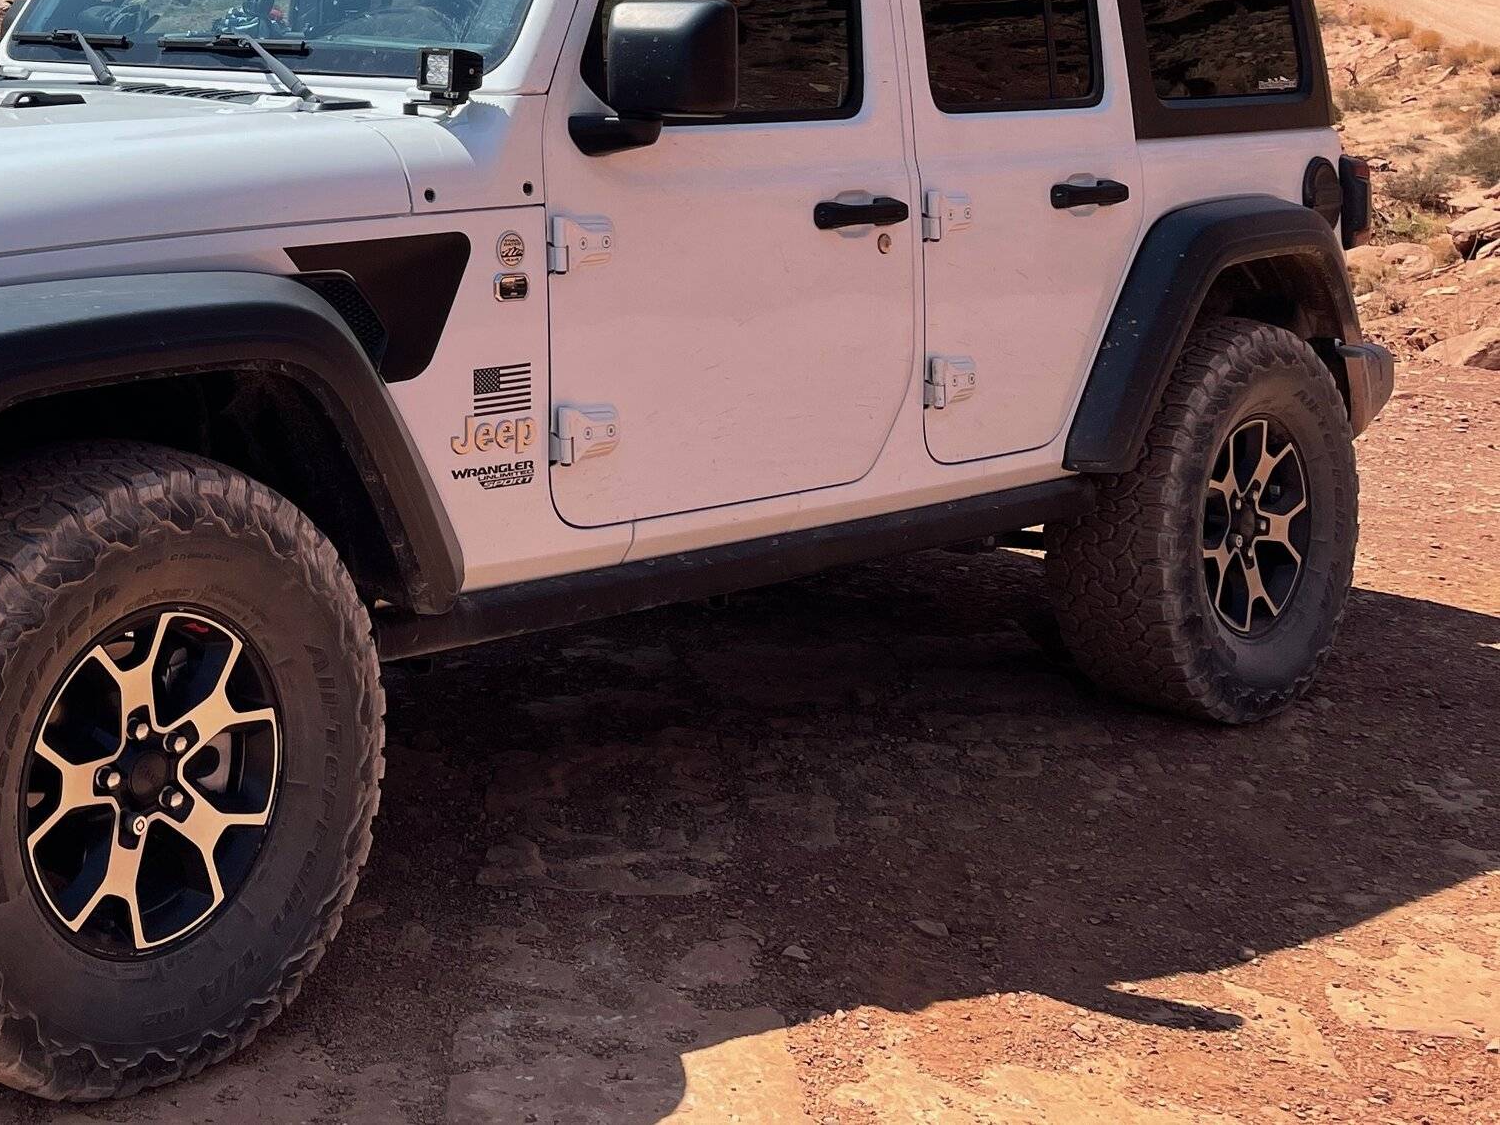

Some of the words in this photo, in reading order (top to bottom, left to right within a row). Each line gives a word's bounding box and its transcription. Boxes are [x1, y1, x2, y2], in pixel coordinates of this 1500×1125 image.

[451, 415, 536, 455] Jeep
[451, 460, 534, 480] WRANGLER
[478, 469, 535, 482] UNLIMITED
[482, 477, 531, 489] SPORT
